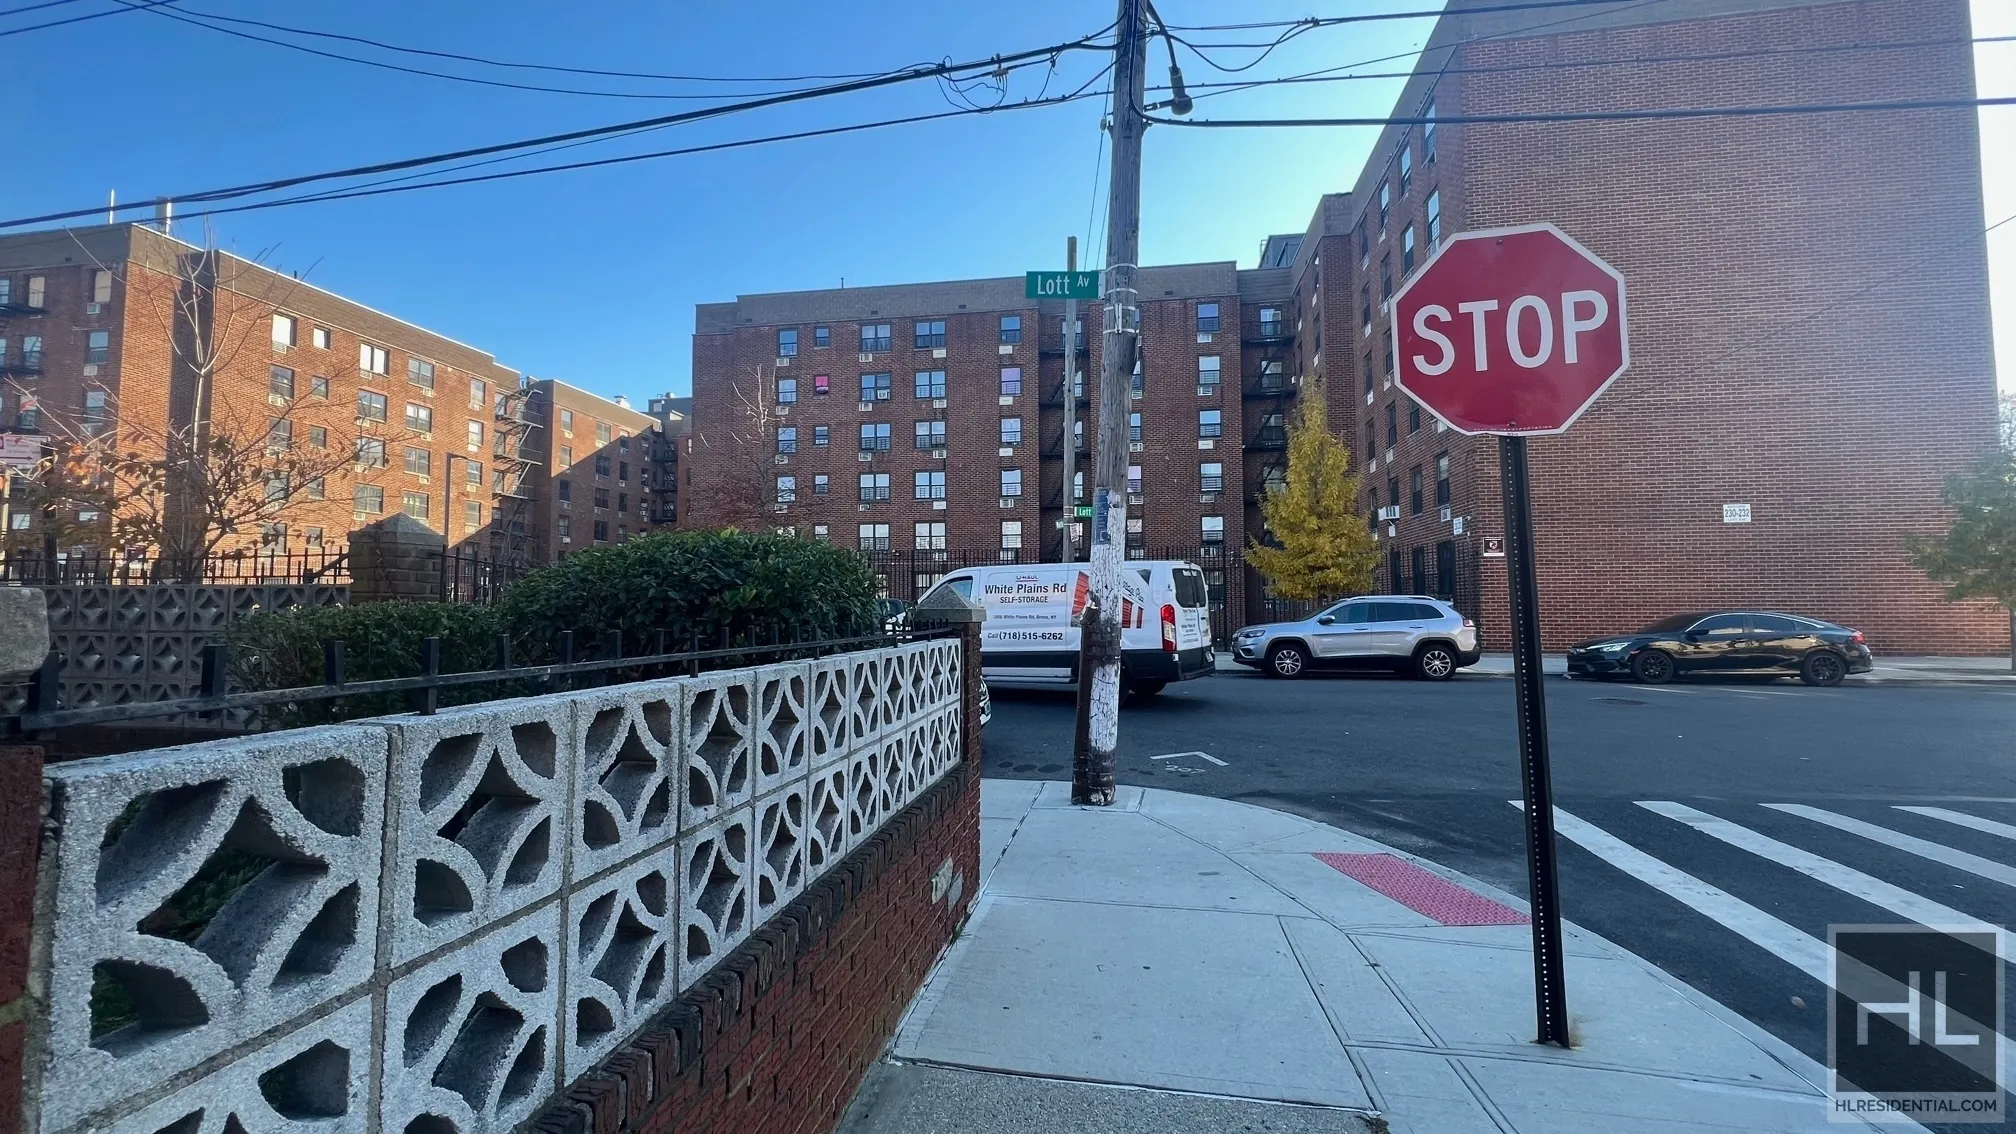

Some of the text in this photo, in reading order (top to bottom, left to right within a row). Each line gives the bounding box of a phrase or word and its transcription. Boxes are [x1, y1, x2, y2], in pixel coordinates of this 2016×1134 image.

[1037, 274, 1090, 295] Lott Av
[1412, 289, 1609, 376] STOP
[1079, 507, 1092, 516] Lott
[1724, 508, 1750, 518] 230-232
[985, 583, 1067, 594] White Plains Rd
[1000, 596, 1049, 604] SELF-STORAGE
[999, 631, 1021, 641] (718)
[1022, 632, 1063, 641] 515-6262
